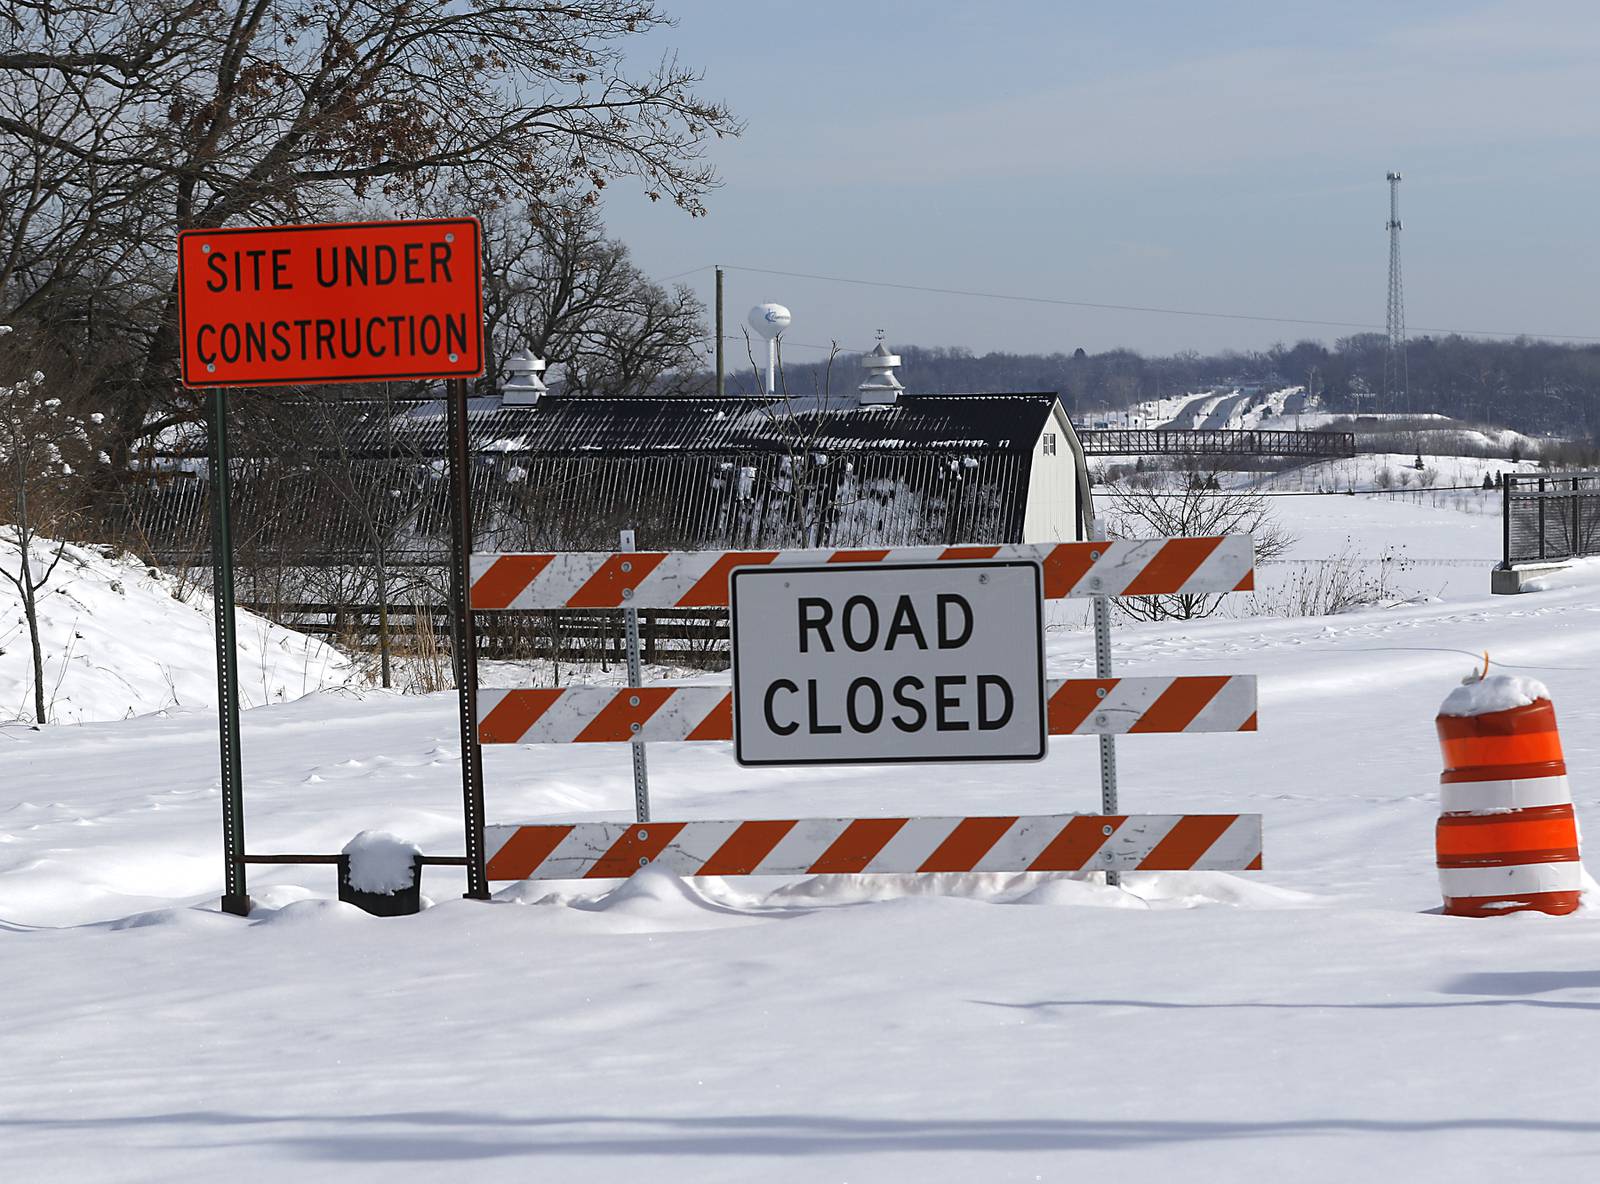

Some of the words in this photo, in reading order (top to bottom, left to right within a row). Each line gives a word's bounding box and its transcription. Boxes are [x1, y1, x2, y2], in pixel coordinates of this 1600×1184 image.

[206, 249, 293, 292] SITE
[316, 242, 453, 288] UNDER
[197, 313, 467, 365] CONSTRUCTION
[798, 593, 974, 653] ROAD
[763, 674, 1014, 736] CLOSED
